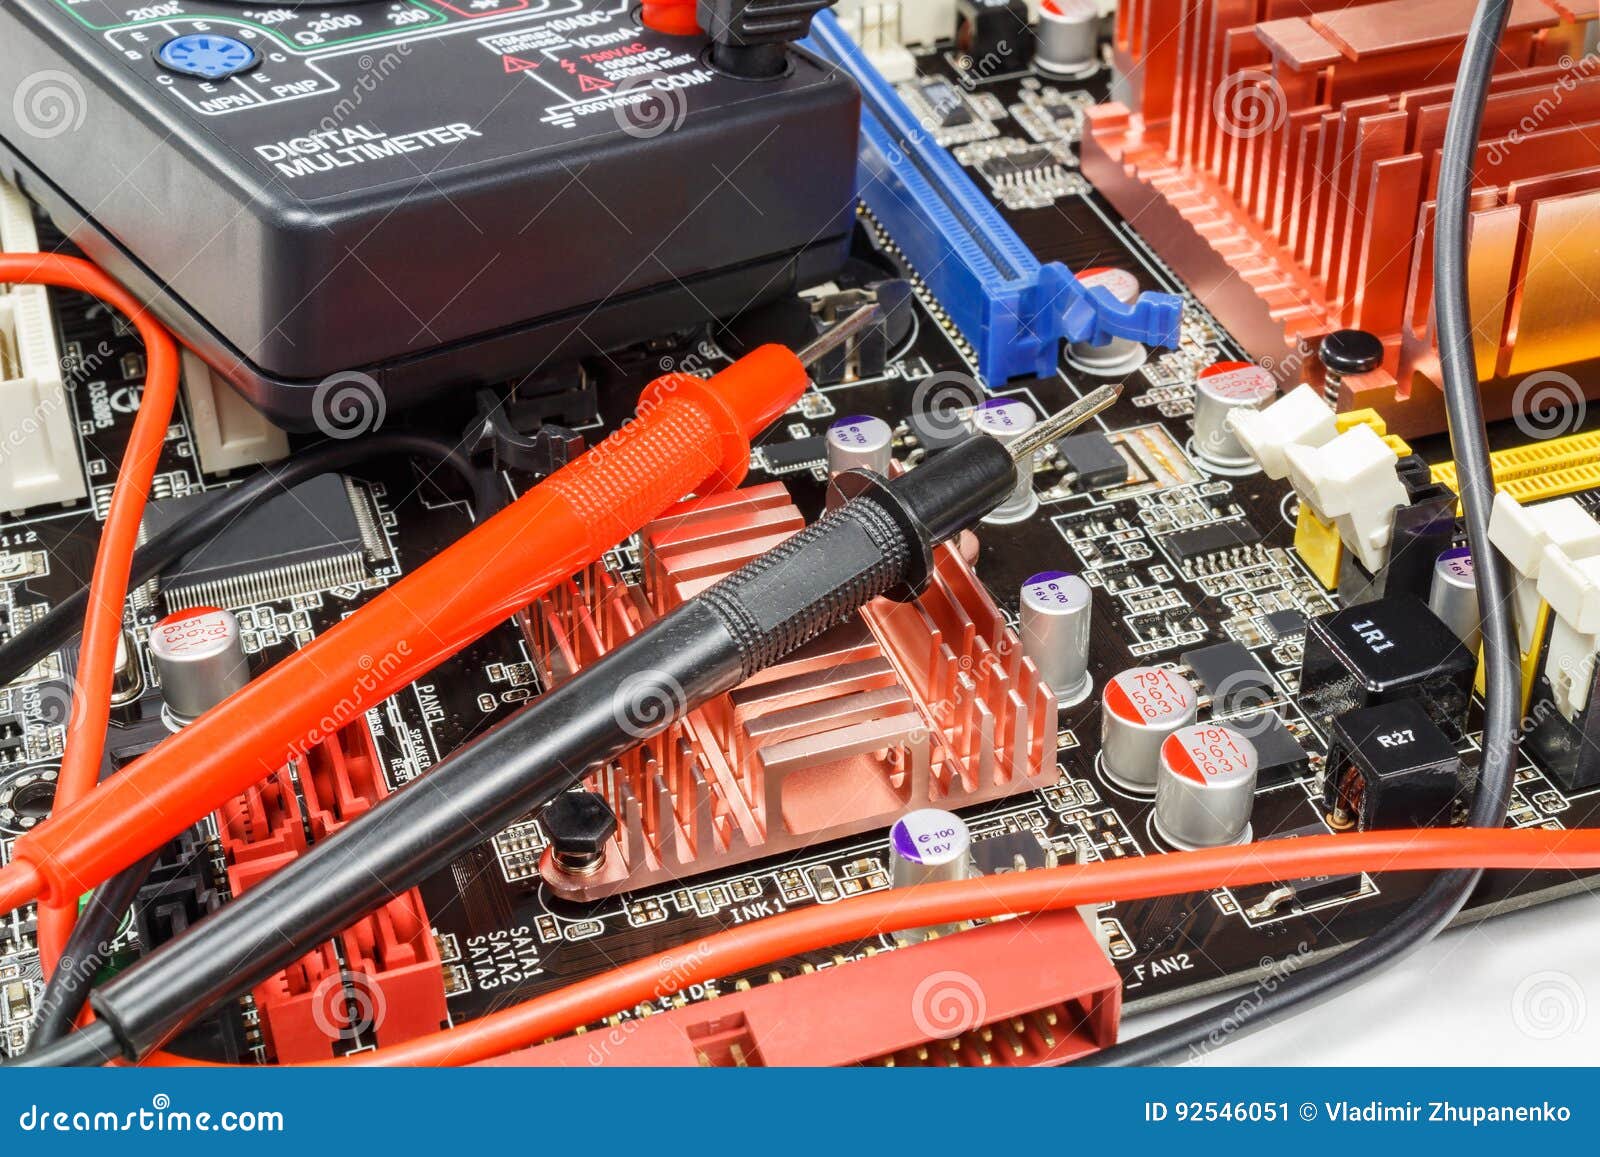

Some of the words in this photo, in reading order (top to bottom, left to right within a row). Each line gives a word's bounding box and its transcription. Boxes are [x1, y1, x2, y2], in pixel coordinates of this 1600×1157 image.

[254, 9, 298, 26] 20k
[307, 14, 363, 34] 2000
[387, 9, 431, 26] 200
[545, 10, 613, 33] 10ADC
[499, 35, 565, 54] unfused
[593, 47, 671, 72] 1000VDC
[660, 52, 697, 70] max
[270, 79, 319, 98] PNP
[651, 69, 710, 91] COM
[200, 93, 255, 112] NPN
[254, 124, 387, 162] DIGITAL
[274, 122, 483, 178] MULTIMETER
[853, 432, 867, 444] 100
[1032, 586, 1050, 602] 16V
[1056, 591, 1069, 605] 100
[183, 618, 211, 646] 561
[206, 619, 230, 641] 791
[1351, 619, 1395, 654] 1R1
[1134, 668, 1169, 689] 791
[1131, 682, 1177, 706] 561
[417, 684, 446, 728] PANEL
[367, 707, 385, 736] PWRSW
[1194, 727, 1231, 745] 791
[1376, 729, 1416, 748] R27
[409, 728, 432, 769] SPEAKER
[1192, 740, 1239, 763] 561
[932, 828, 956, 839] 100
[925, 842, 953, 856] 16V
[466, 935, 500, 990] SATA3
[488, 930, 522, 985] SATA2
[510, 926, 544, 979] SATA1
